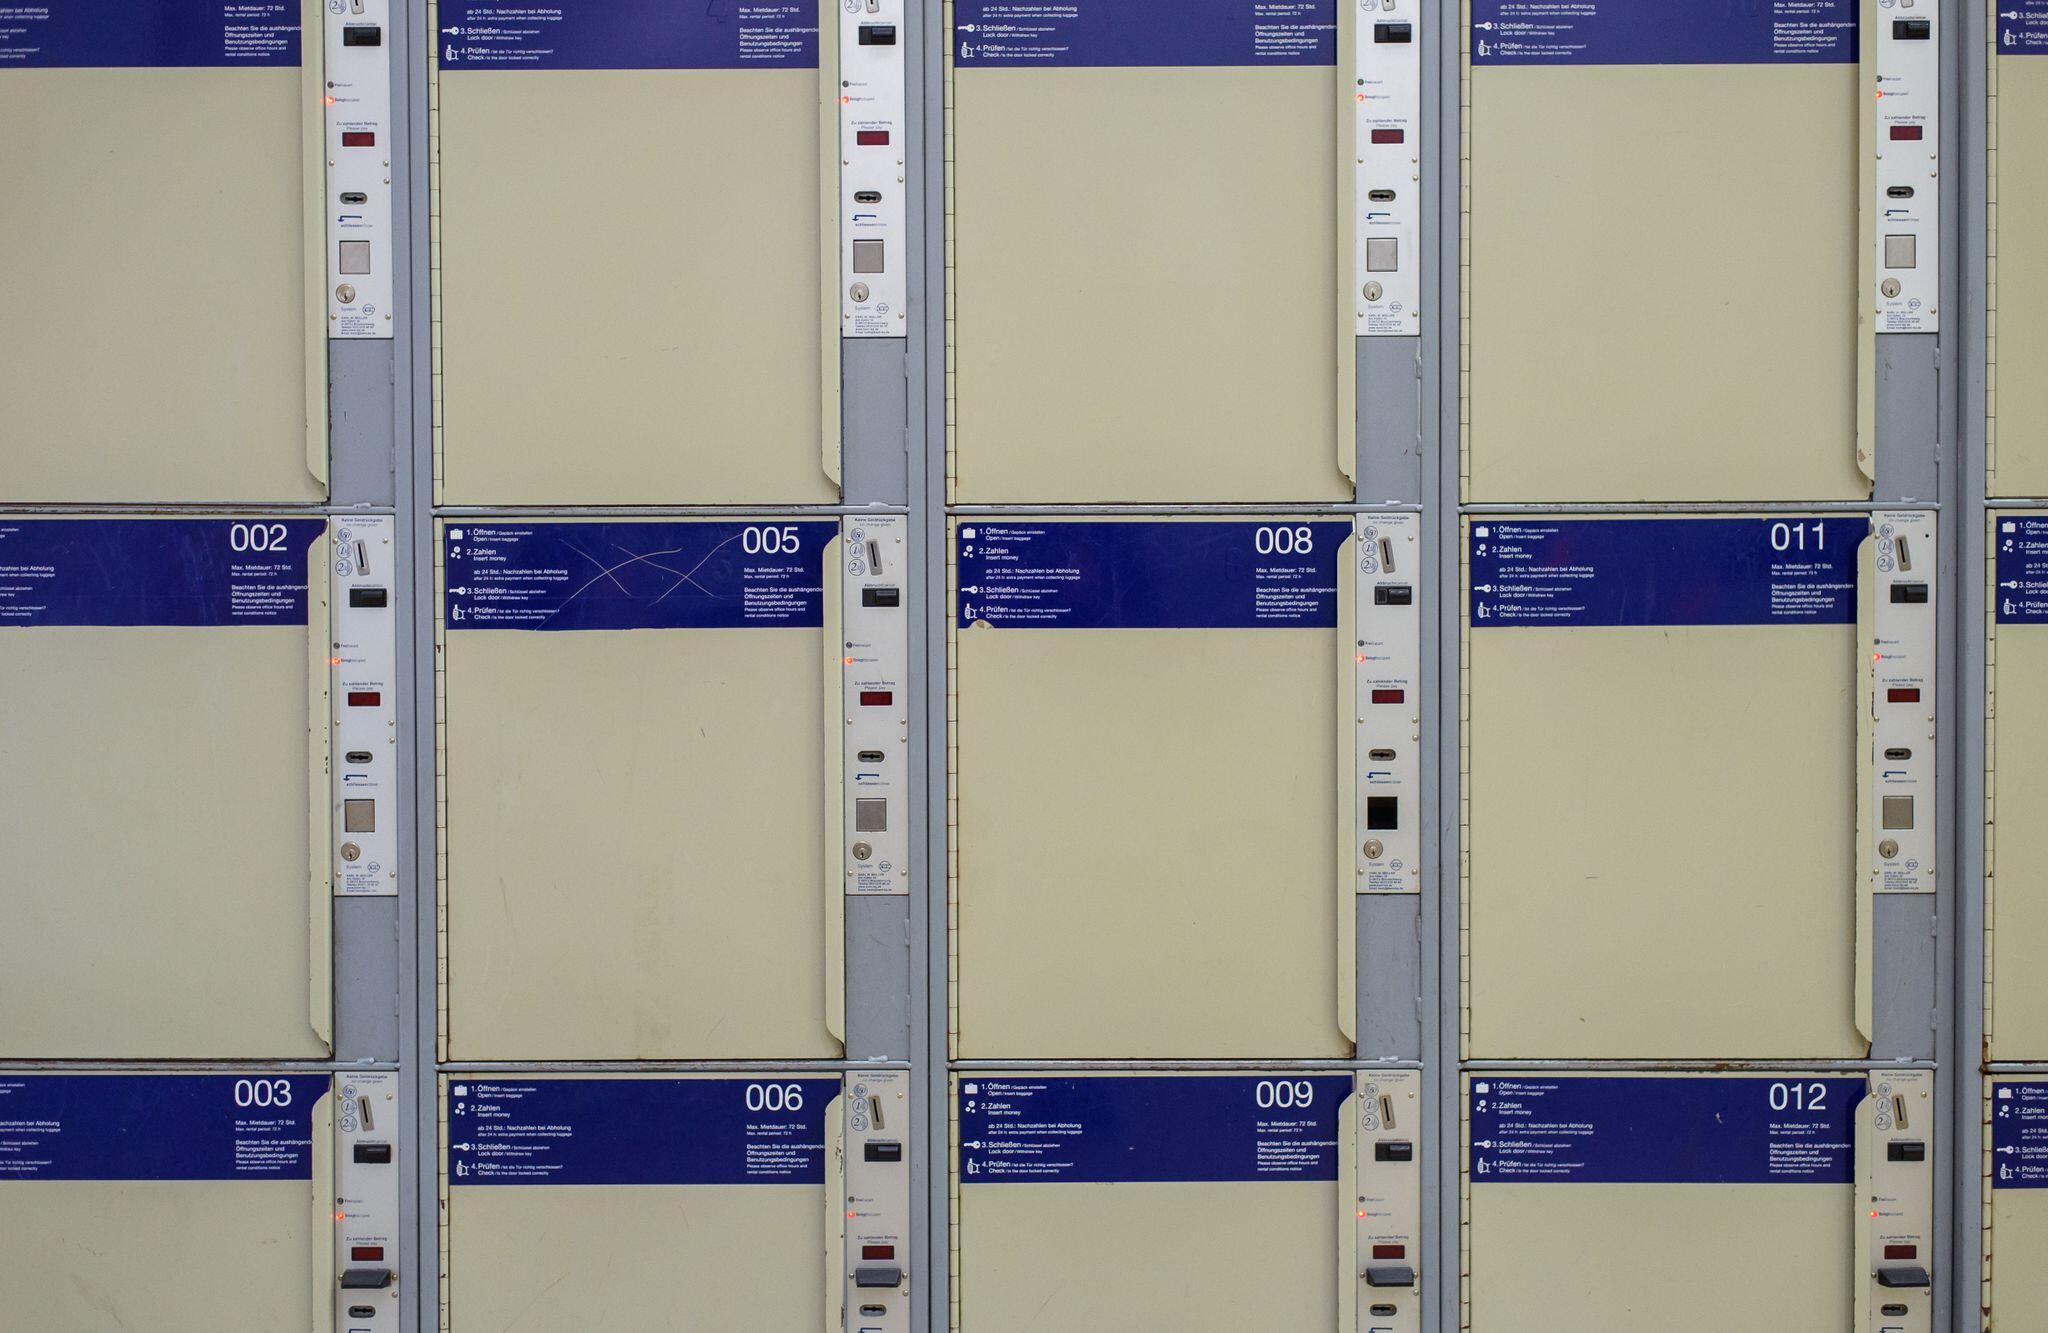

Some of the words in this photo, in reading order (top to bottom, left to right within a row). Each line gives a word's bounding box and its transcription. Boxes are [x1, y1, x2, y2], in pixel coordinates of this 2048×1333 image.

[230, 524, 288, 551] 002
[743, 526, 800, 554] 005
[1256, 527, 1312, 554] 008
[1771, 522, 1824, 550] 011
[235, 1079, 292, 1106] 003
[746, 1084, 803, 1111] 006
[1256, 1080, 1313, 1108] 009
[1769, 1083, 1826, 1110] 012
